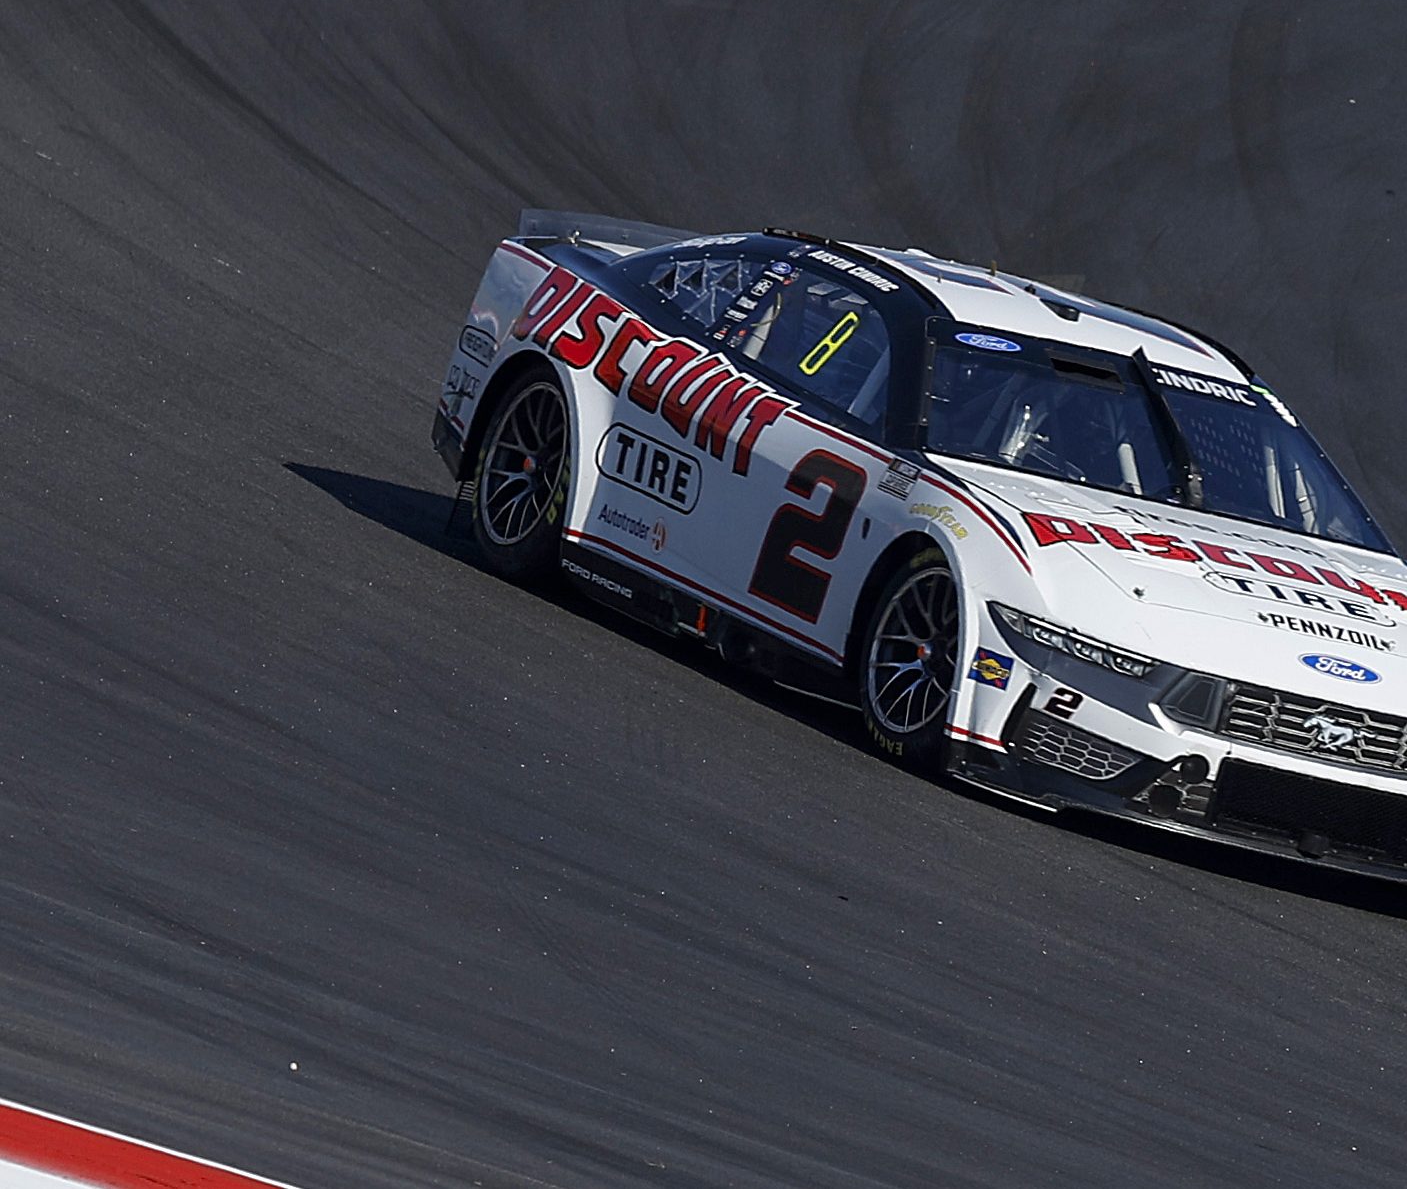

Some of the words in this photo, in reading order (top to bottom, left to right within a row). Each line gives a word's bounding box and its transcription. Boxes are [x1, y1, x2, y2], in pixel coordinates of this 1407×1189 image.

[807, 249, 852, 272] AUSTIN
[848, 263, 900, 293] CINDRIC
[514, 266, 799, 477] DISCOUNT
[614, 424, 694, 506] TIRE
[598, 503, 651, 541] Autotrader
[748, 448, 869, 624] 2
[561, 558, 591, 580] FORD
[591, 573, 633, 599] RACING
[1219, 575, 1380, 622] TIRE
[1269, 612, 1385, 651] PENNZOIL
[1043, 687, 1084, 720] 2
